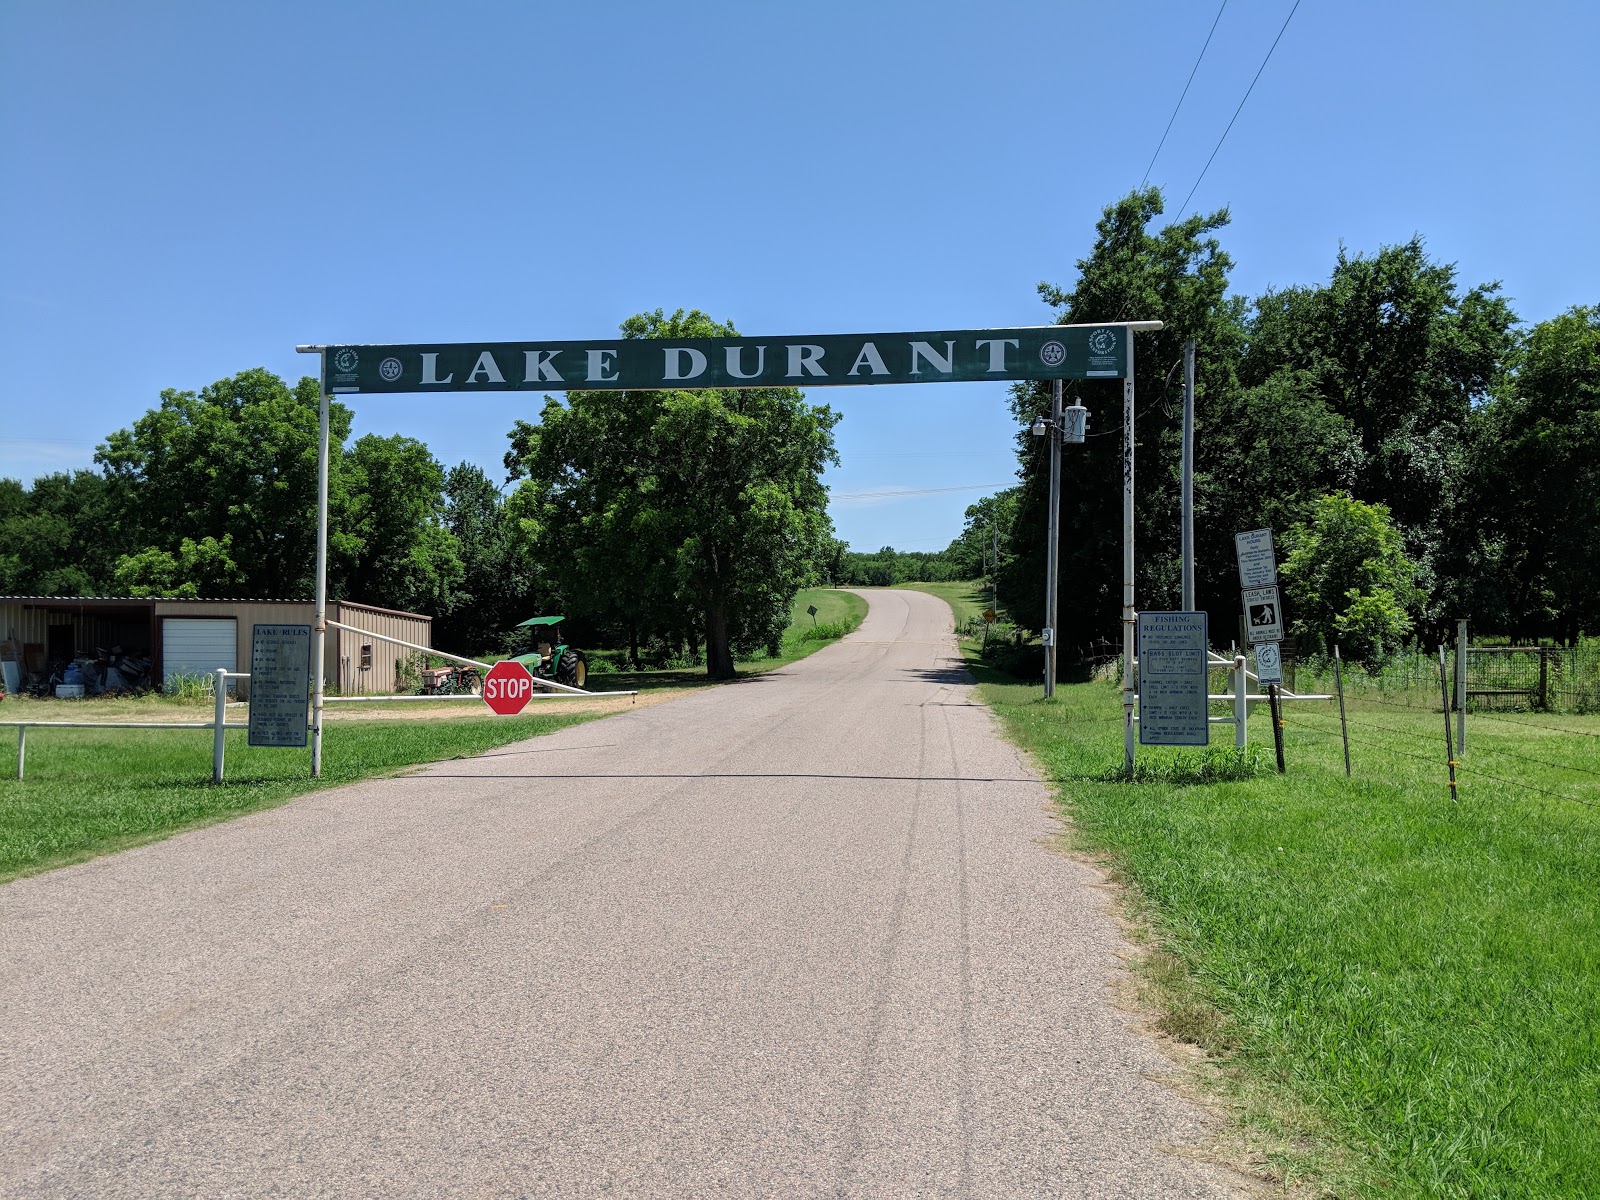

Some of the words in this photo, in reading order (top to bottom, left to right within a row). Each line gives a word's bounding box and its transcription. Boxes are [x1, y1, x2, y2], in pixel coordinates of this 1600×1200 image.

[419, 349, 620, 385] LAKE
[662, 338, 1020, 380] DURANT
[486, 678, 530, 698] STOP
